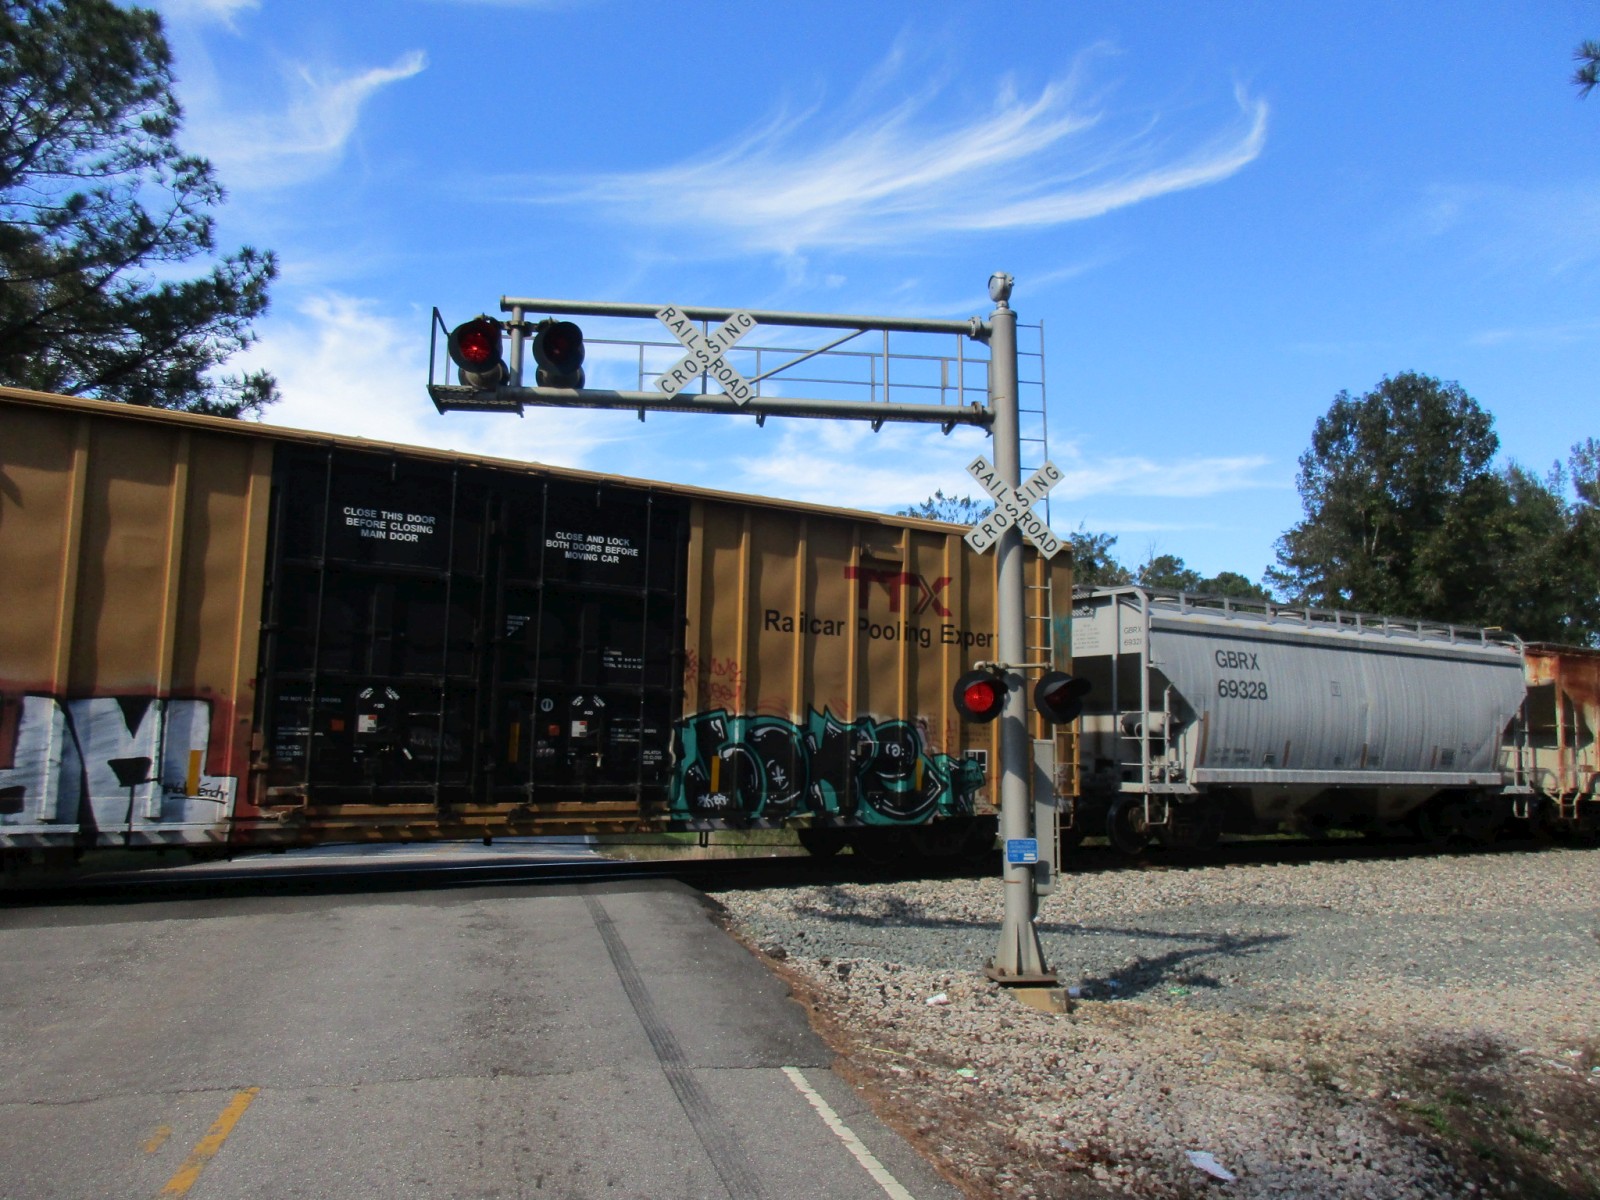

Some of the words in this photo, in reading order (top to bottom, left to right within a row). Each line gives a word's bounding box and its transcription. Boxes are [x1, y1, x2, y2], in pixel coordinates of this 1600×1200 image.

[660, 313, 752, 394] CROSSING
[343, 506, 378, 519] CLOSE
[380, 510, 404, 521] THIS
[406, 514, 436, 525] DOOR
[971, 466, 1059, 549] CROSSING
[345, 517, 387, 529] BEFORE
[389, 522, 434, 534] CLOSING
[360, 528, 386, 539] MAIN
[389, 532, 419, 542] DOOR
[545, 539, 570, 549] BOTH
[572, 542, 602, 553] DOORS
[604, 546, 639, 556] BEFORE
[555, 531, 584, 542] CLOSE
[586, 534, 605, 544] AND
[606, 536, 630, 546] LOCK
[564, 551, 598, 562] MOVING
[600, 554, 620, 564] CAR
[844, 566, 953, 617] TTX
[764, 609, 846, 637] Railcar
[857, 617, 931, 648] Pooling
[940, 624, 1000, 650] Exper
[1215, 649, 1260, 671] GBRX
[1218, 679, 1268, 701] 69328
